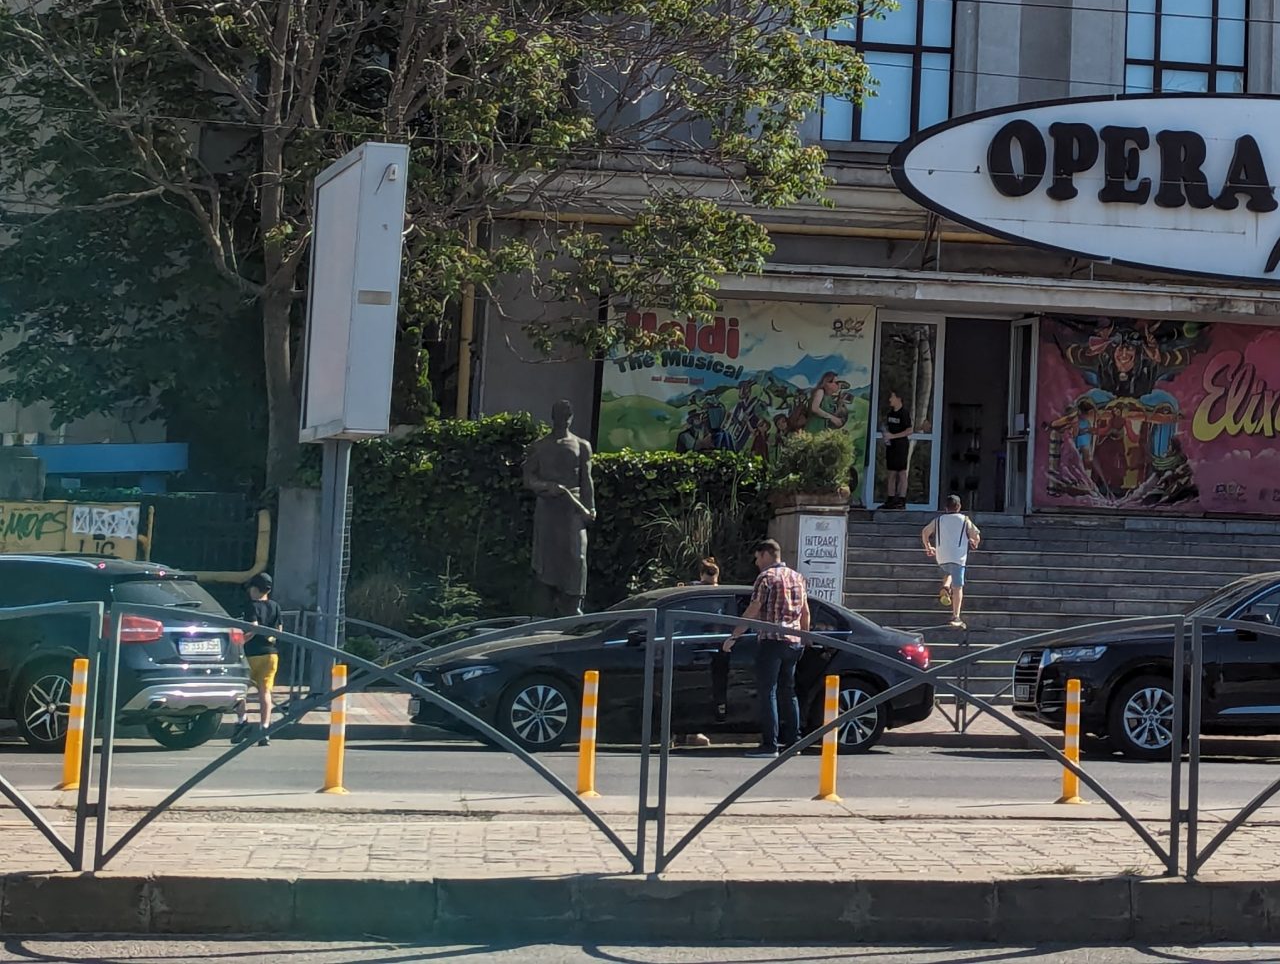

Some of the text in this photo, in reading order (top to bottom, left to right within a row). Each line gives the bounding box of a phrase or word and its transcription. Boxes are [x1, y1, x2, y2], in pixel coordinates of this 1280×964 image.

[986, 119, 1279, 212] OPERA
[613, 351, 744, 380] The Musical
[805, 535, 839, 548] INTRARE
[806, 577, 837, 589] NTRARE
